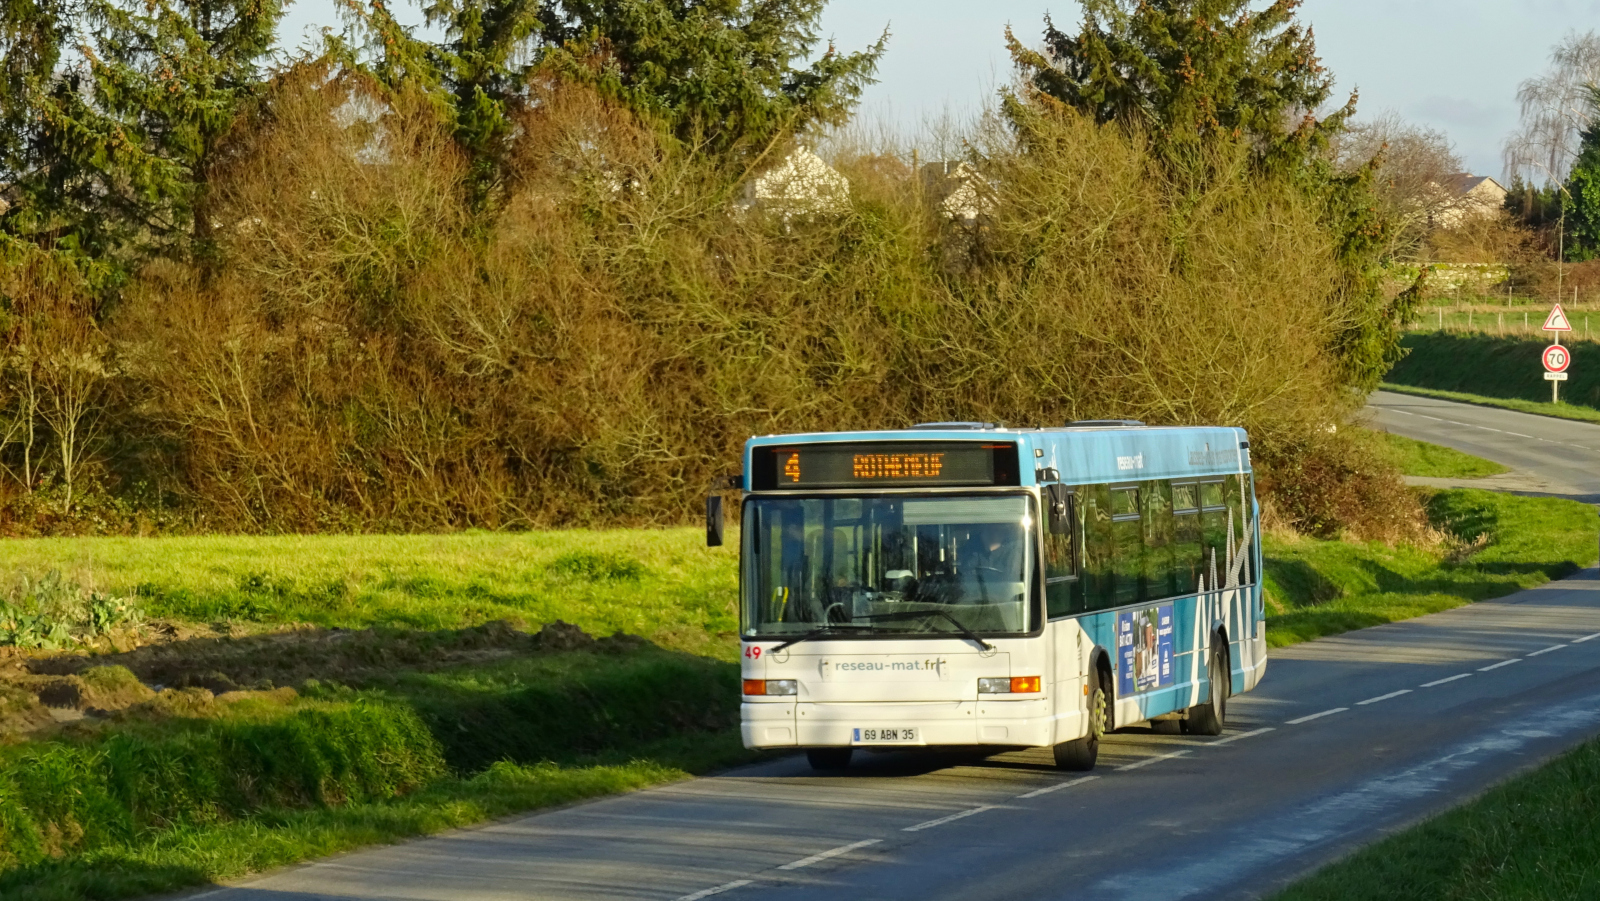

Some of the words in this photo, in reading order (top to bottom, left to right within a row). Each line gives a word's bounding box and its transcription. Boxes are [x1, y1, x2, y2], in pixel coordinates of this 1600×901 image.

[1548, 353, 1565, 365] 70
[784, 453, 800, 482] 4
[744, 646, 762, 660] 49
[835, 659, 936, 671] reseau-mat.fr
[864, 729, 877, 740] 69
[880, 729, 898, 740] ABN
[902, 728, 914, 740] 35
